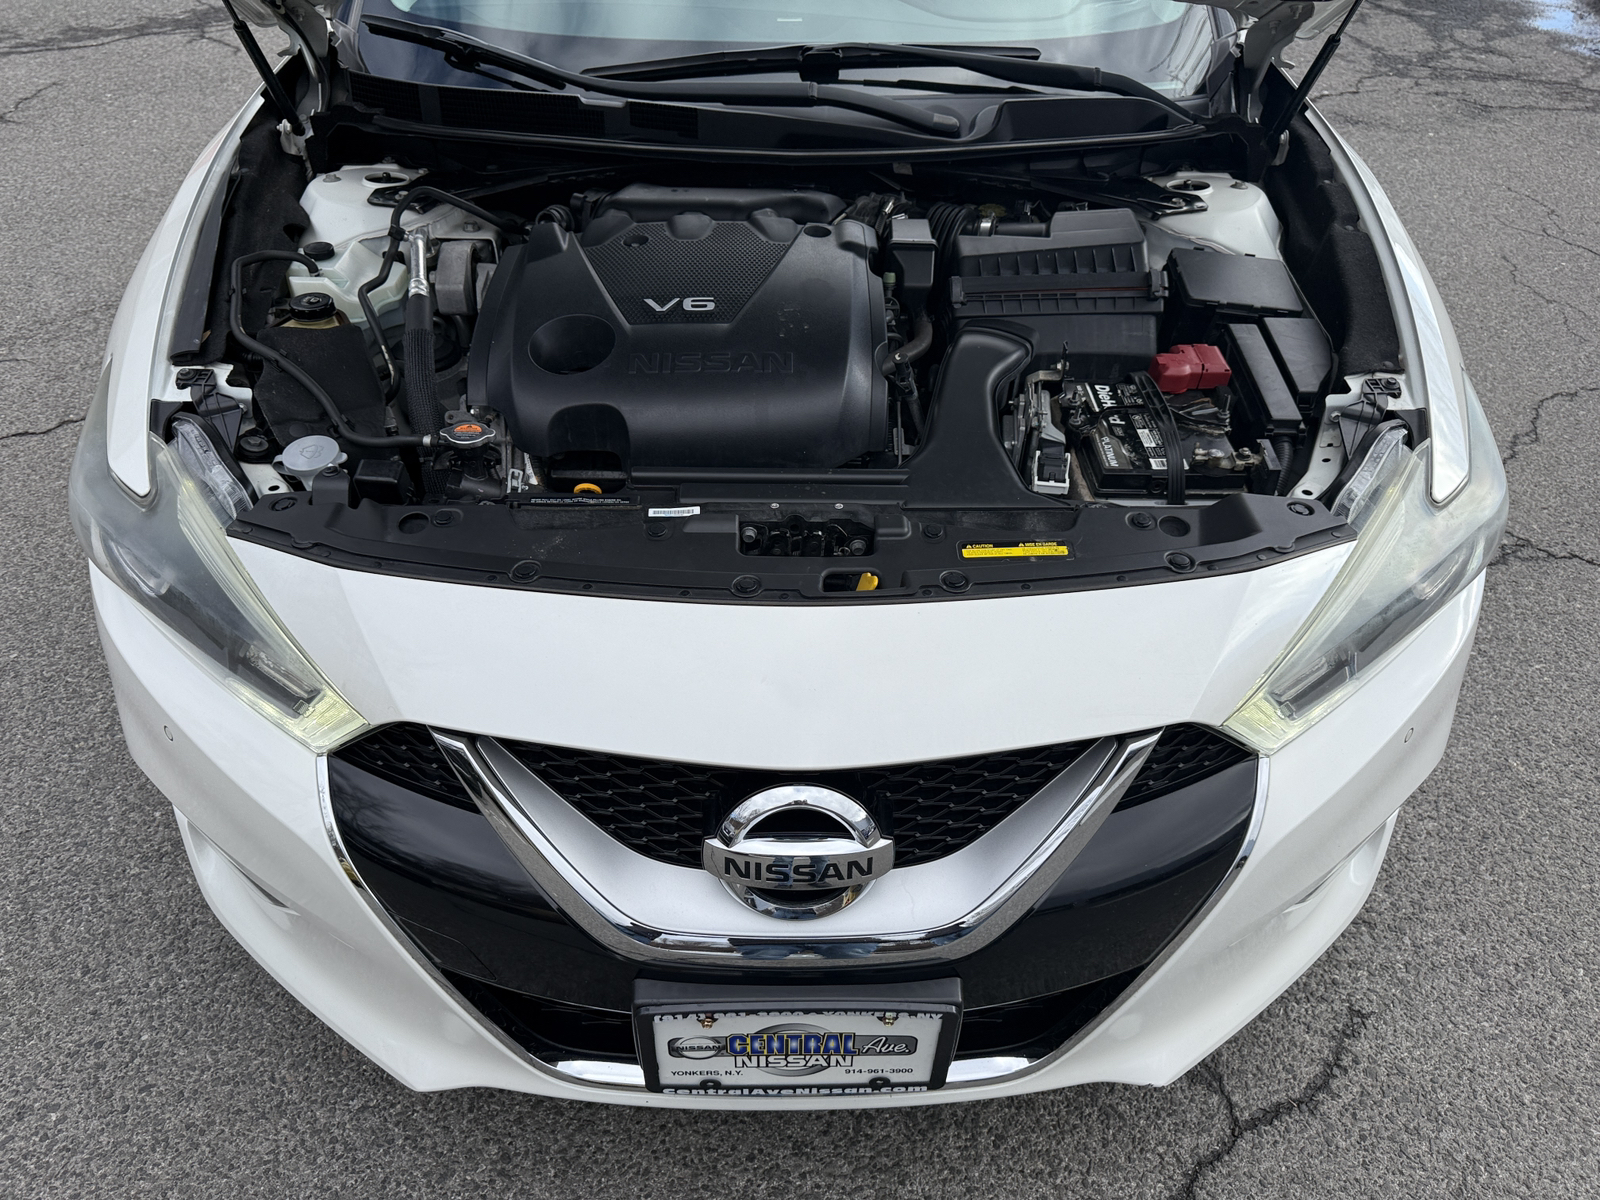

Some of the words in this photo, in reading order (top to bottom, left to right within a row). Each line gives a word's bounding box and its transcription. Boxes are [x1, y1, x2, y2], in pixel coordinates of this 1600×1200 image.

[643, 297, 716, 313] V6
[628, 352, 793, 375] NISSAN
[1101, 436, 1119, 467] PLATINUM
[724, 857, 874, 882] NISSAN
[726, 1033, 860, 1056] CENTRAL
[861, 1036, 910, 1054] Ave.
[734, 1055, 854, 1068] NISSAN
